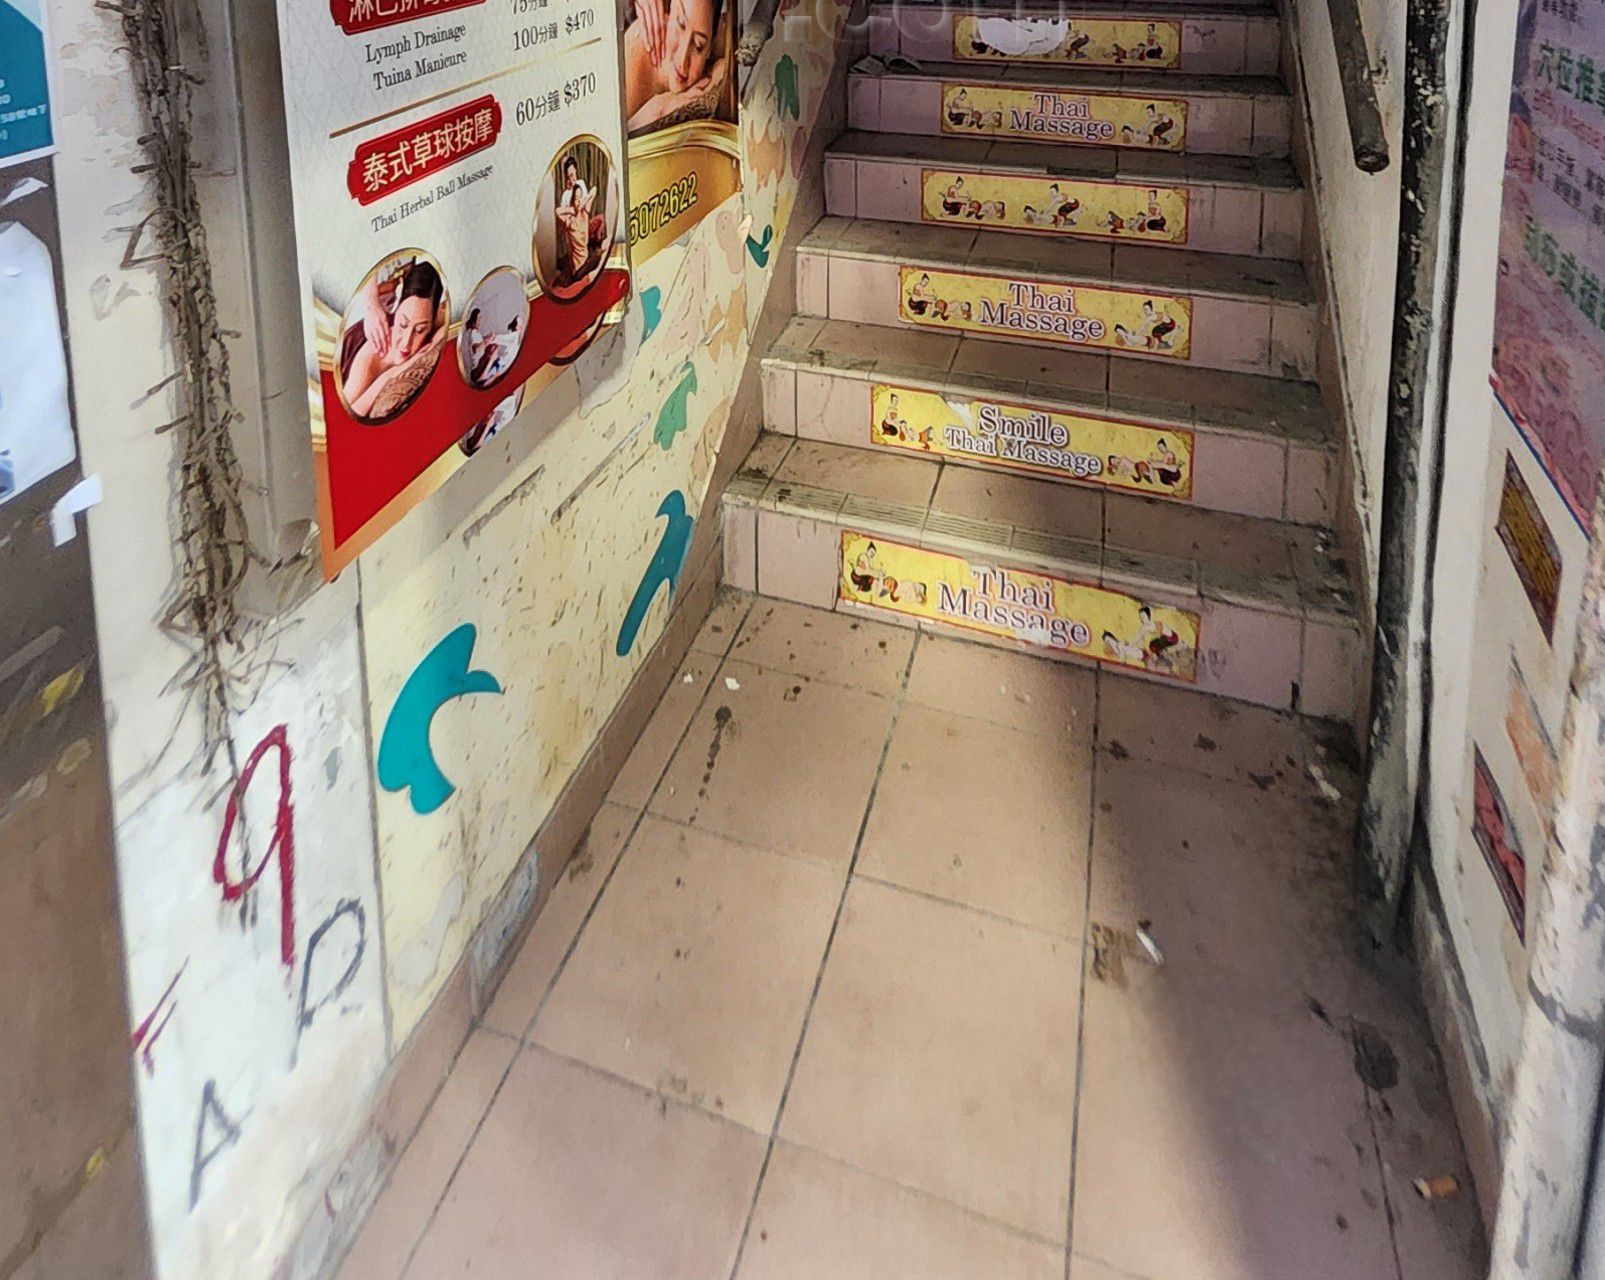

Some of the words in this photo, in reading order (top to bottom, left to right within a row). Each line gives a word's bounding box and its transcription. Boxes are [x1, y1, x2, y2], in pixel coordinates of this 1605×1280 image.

[364, 35, 411, 64] Lymph
[414, 22, 466, 48] Drainage
[512, 22, 558, 51] 100分鐘
[565, 8, 595, 36] $470
[373, 66, 412, 91] Tuina
[414, 49, 468, 78] Manicure
[515, 91, 560, 126] 60分鐘
[563, 72, 596, 108] $370
[1033, 93, 1089, 118] Thai
[1008, 109, 1115, 142] Massage
[362, 108, 495, 193] 泰式草球按摩
[371, 209, 397, 233] Thai
[399, 190, 434, 220] Herbal
[436, 181, 456, 204] Ball
[457, 164, 494, 191] Massage
[1008, 282, 1075, 314] Thai
[978, 300, 1105, 340] Massage
[977, 406, 1069, 447] Smile
[942, 427, 997, 455] Thai
[1001, 440, 1102, 477] Massage
[973, 568, 1056, 612] Thai
[937, 582, 1090, 646] Massage
